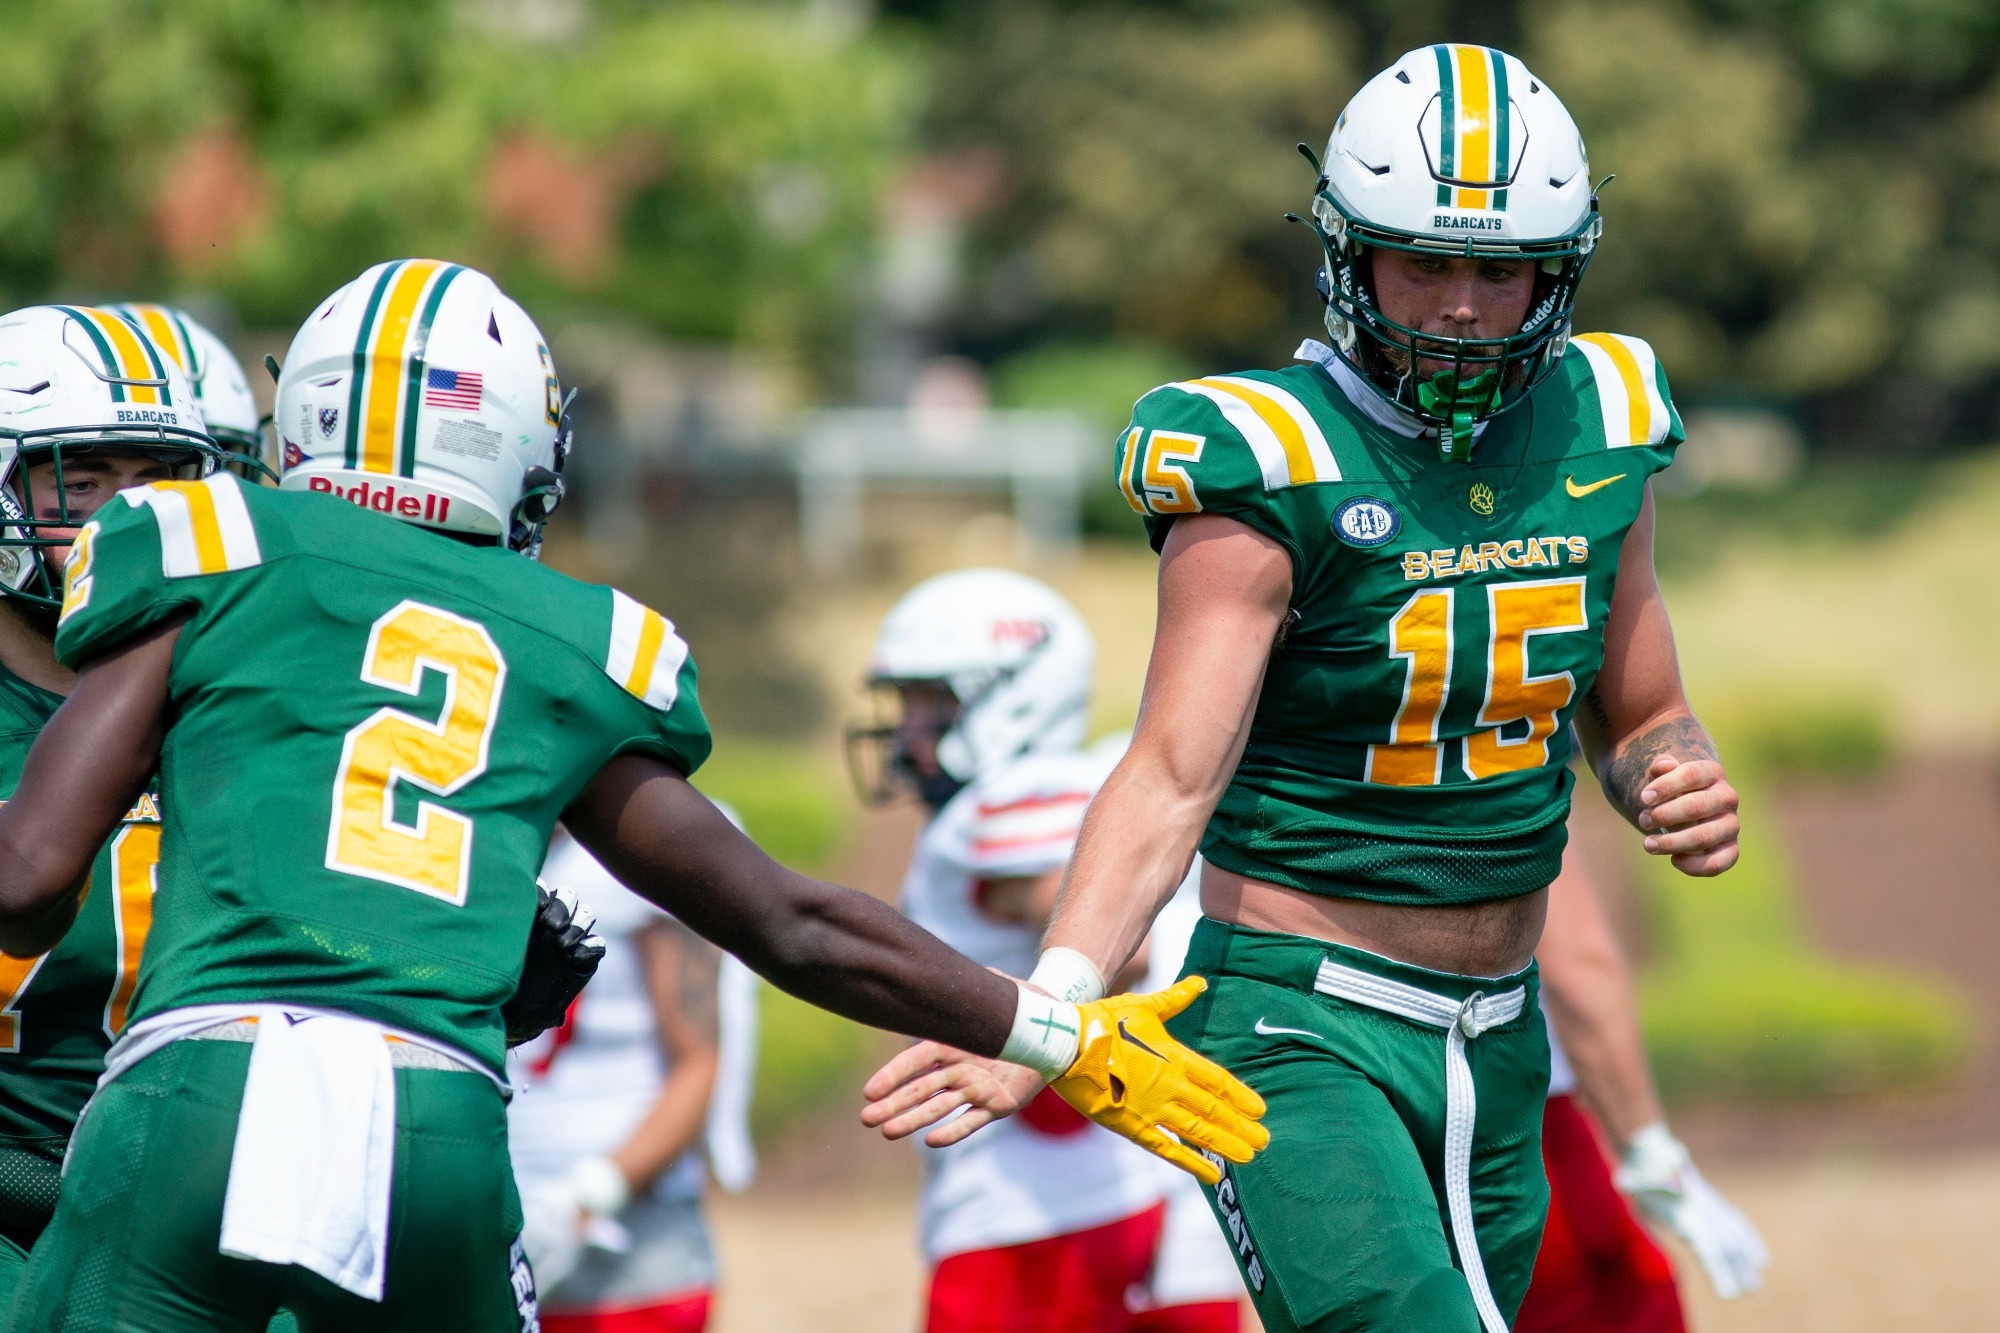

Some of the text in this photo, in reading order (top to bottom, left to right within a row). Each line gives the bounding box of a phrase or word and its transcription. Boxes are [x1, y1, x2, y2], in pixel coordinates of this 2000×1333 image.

[1433, 214, 1502, 231] BEARCATS
[116, 410, 178, 425] BEARCATS
[1118, 426, 1207, 517] 15
[1347, 511, 1386, 534] PAC
[56, 520, 101, 629] 2
[1401, 536, 1589, 582] BEARCATS
[1364, 576, 1589, 786] 15
[324, 598, 508, 908] 2
